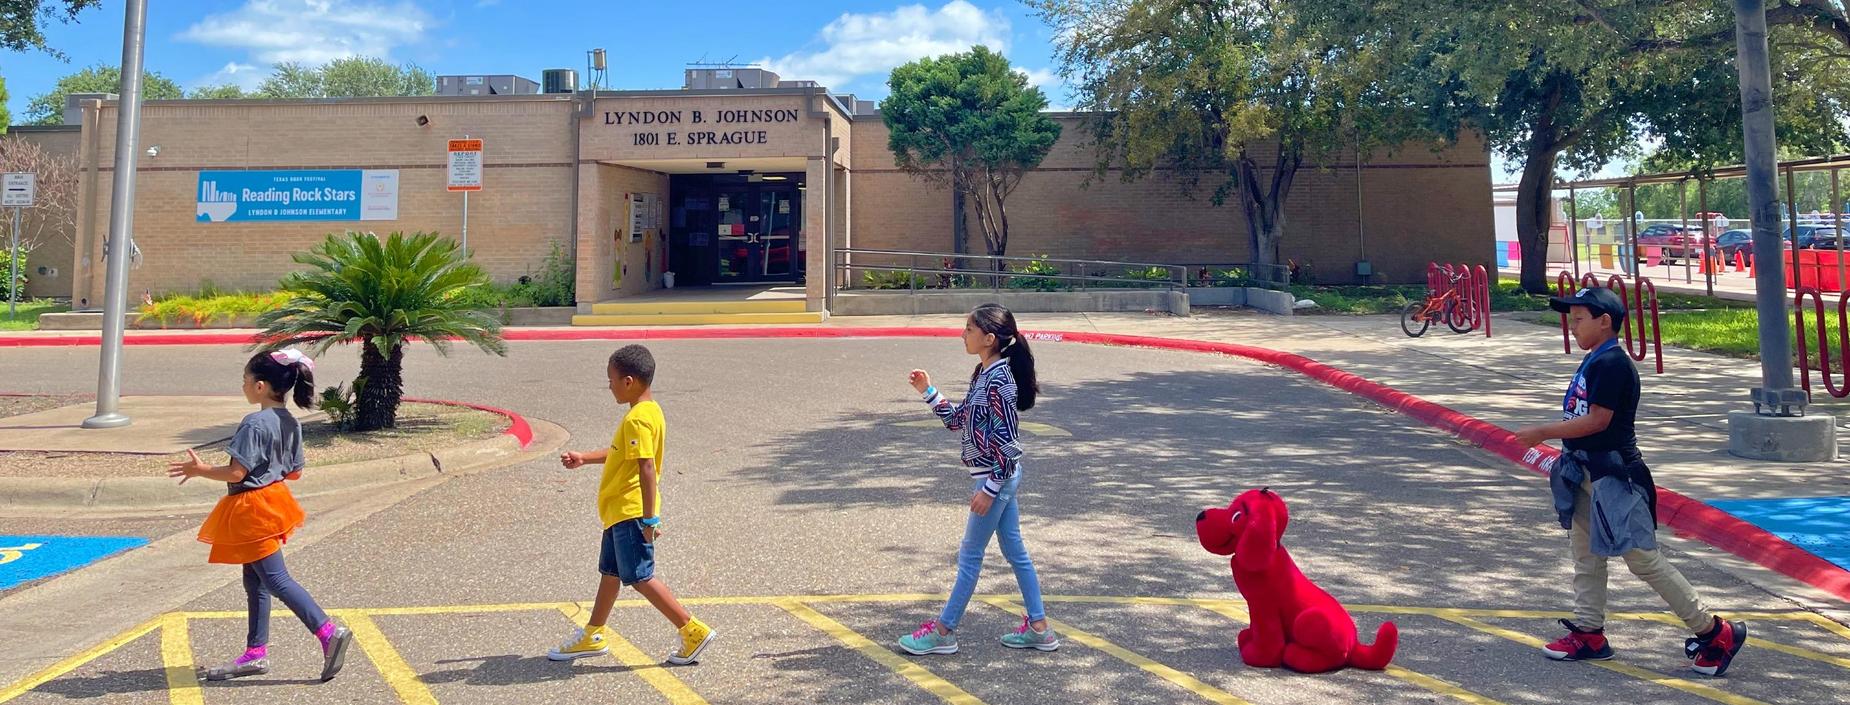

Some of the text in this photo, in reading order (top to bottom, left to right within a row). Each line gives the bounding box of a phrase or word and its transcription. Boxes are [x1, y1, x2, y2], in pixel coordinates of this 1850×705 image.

[604, 109, 799, 125] LYNDON B. JOHNSON
[633, 130, 768, 146] 1801 E. SPRAGUE
[242, 187, 356, 205] Reading Rock Stars
[280, 208, 308, 216] JOHNSON
[309, 208, 347, 216] ELEMENTARY
[1522, 447, 1544, 465] TOW
